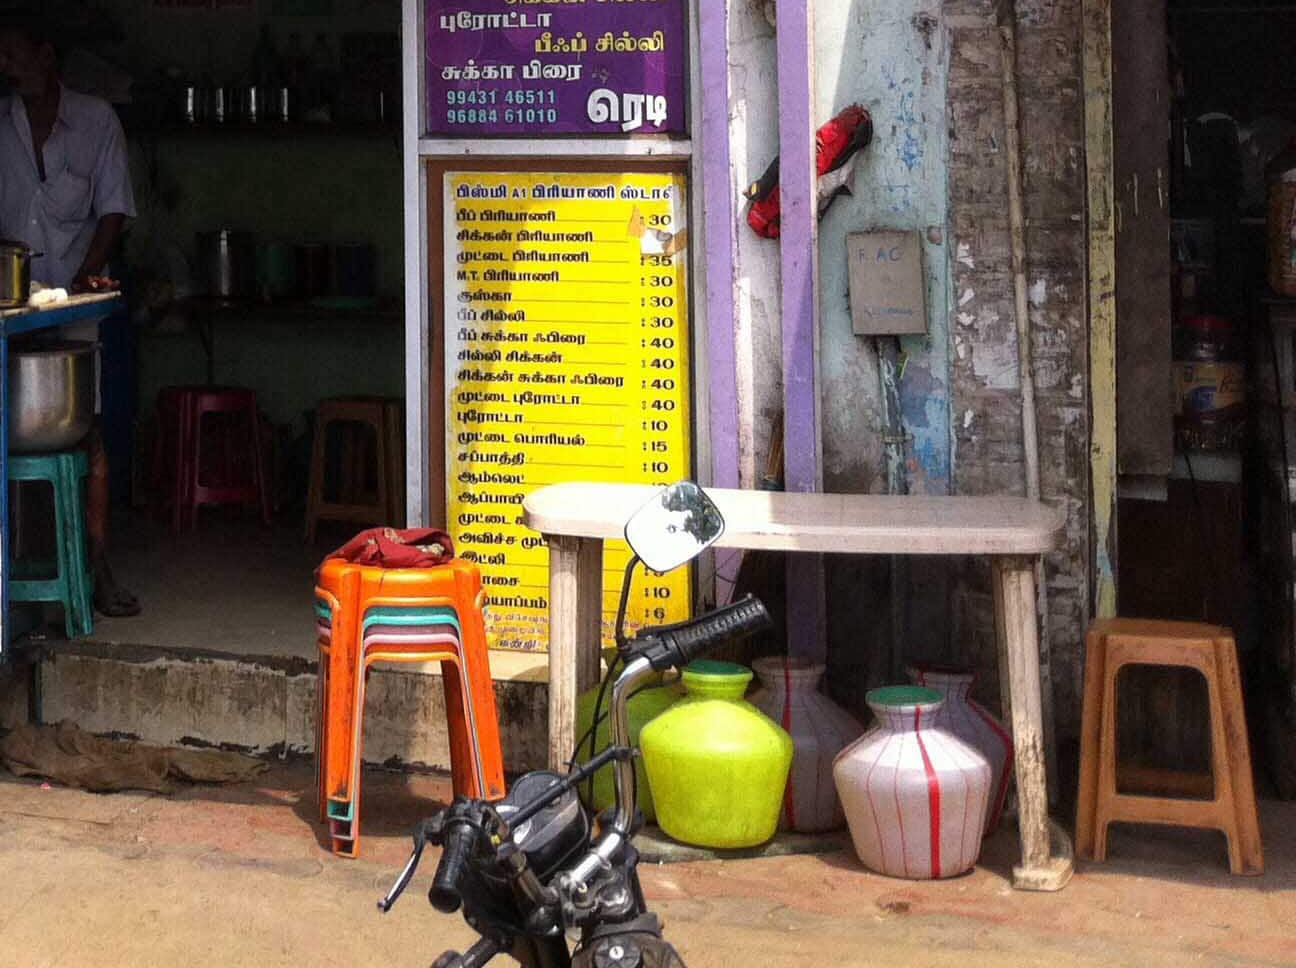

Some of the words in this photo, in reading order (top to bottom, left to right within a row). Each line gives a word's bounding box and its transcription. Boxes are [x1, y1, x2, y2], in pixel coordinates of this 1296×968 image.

[440, 11, 552, 32] புரோட்டா
[595, 31, 665, 52] சில்லி
[442, 59, 515, 80] சுக்கா
[447, 90, 497, 105] 99431
[504, 90, 555, 105] 46511
[447, 109, 497, 123] 96884
[504, 109, 557, 123] 61010
[587, 89, 667, 132] ரெடி
[457, 184, 507, 199] பிஸ்மி
[532, 184, 615, 199] பிரியாணி
[480, 210, 556, 222] பிரியாணி
[649, 215, 672, 226] 30
[456, 230, 513, 242] சிக்கன்
[516, 231, 593, 243] பிரியாணி
[456, 251, 507, 264] முட்டை
[512, 251, 589, 263] பிரியாணி
[483, 270, 559, 282] பிரியாணி
[650, 275, 674, 287] 30
[650, 297, 674, 308] 30
[480, 309, 526, 321] சில்லி
[650, 317, 674, 328] 30
[480, 330, 528, 342] சுக்கா
[650, 338, 674, 349] 40
[457, 349, 502, 362] சில்லி
[505, 351, 563, 363] சிக்கன்
[650, 358, 674, 369] 40
[457, 370, 514, 382] சிக்கன்
[518, 372, 566, 384] சுக்கா
[651, 379, 675, 390] 40
[457, 392, 510, 404] முட்டை
[513, 393, 580, 405] புரோட்டா
[651, 400, 675, 411] 40
[457, 410, 524, 423] புரோட்டா
[651, 420, 668, 432] 10
[457, 432, 510, 444] முட்டை
[513, 433, 586, 446] பொரியல்
[651, 441, 668, 452] 15
[458, 452, 525, 465] சப்பாத்தி
[651, 462, 669, 473] 10
[458, 514, 510, 526] முட்டை
[653, 587, 670, 599] 10
